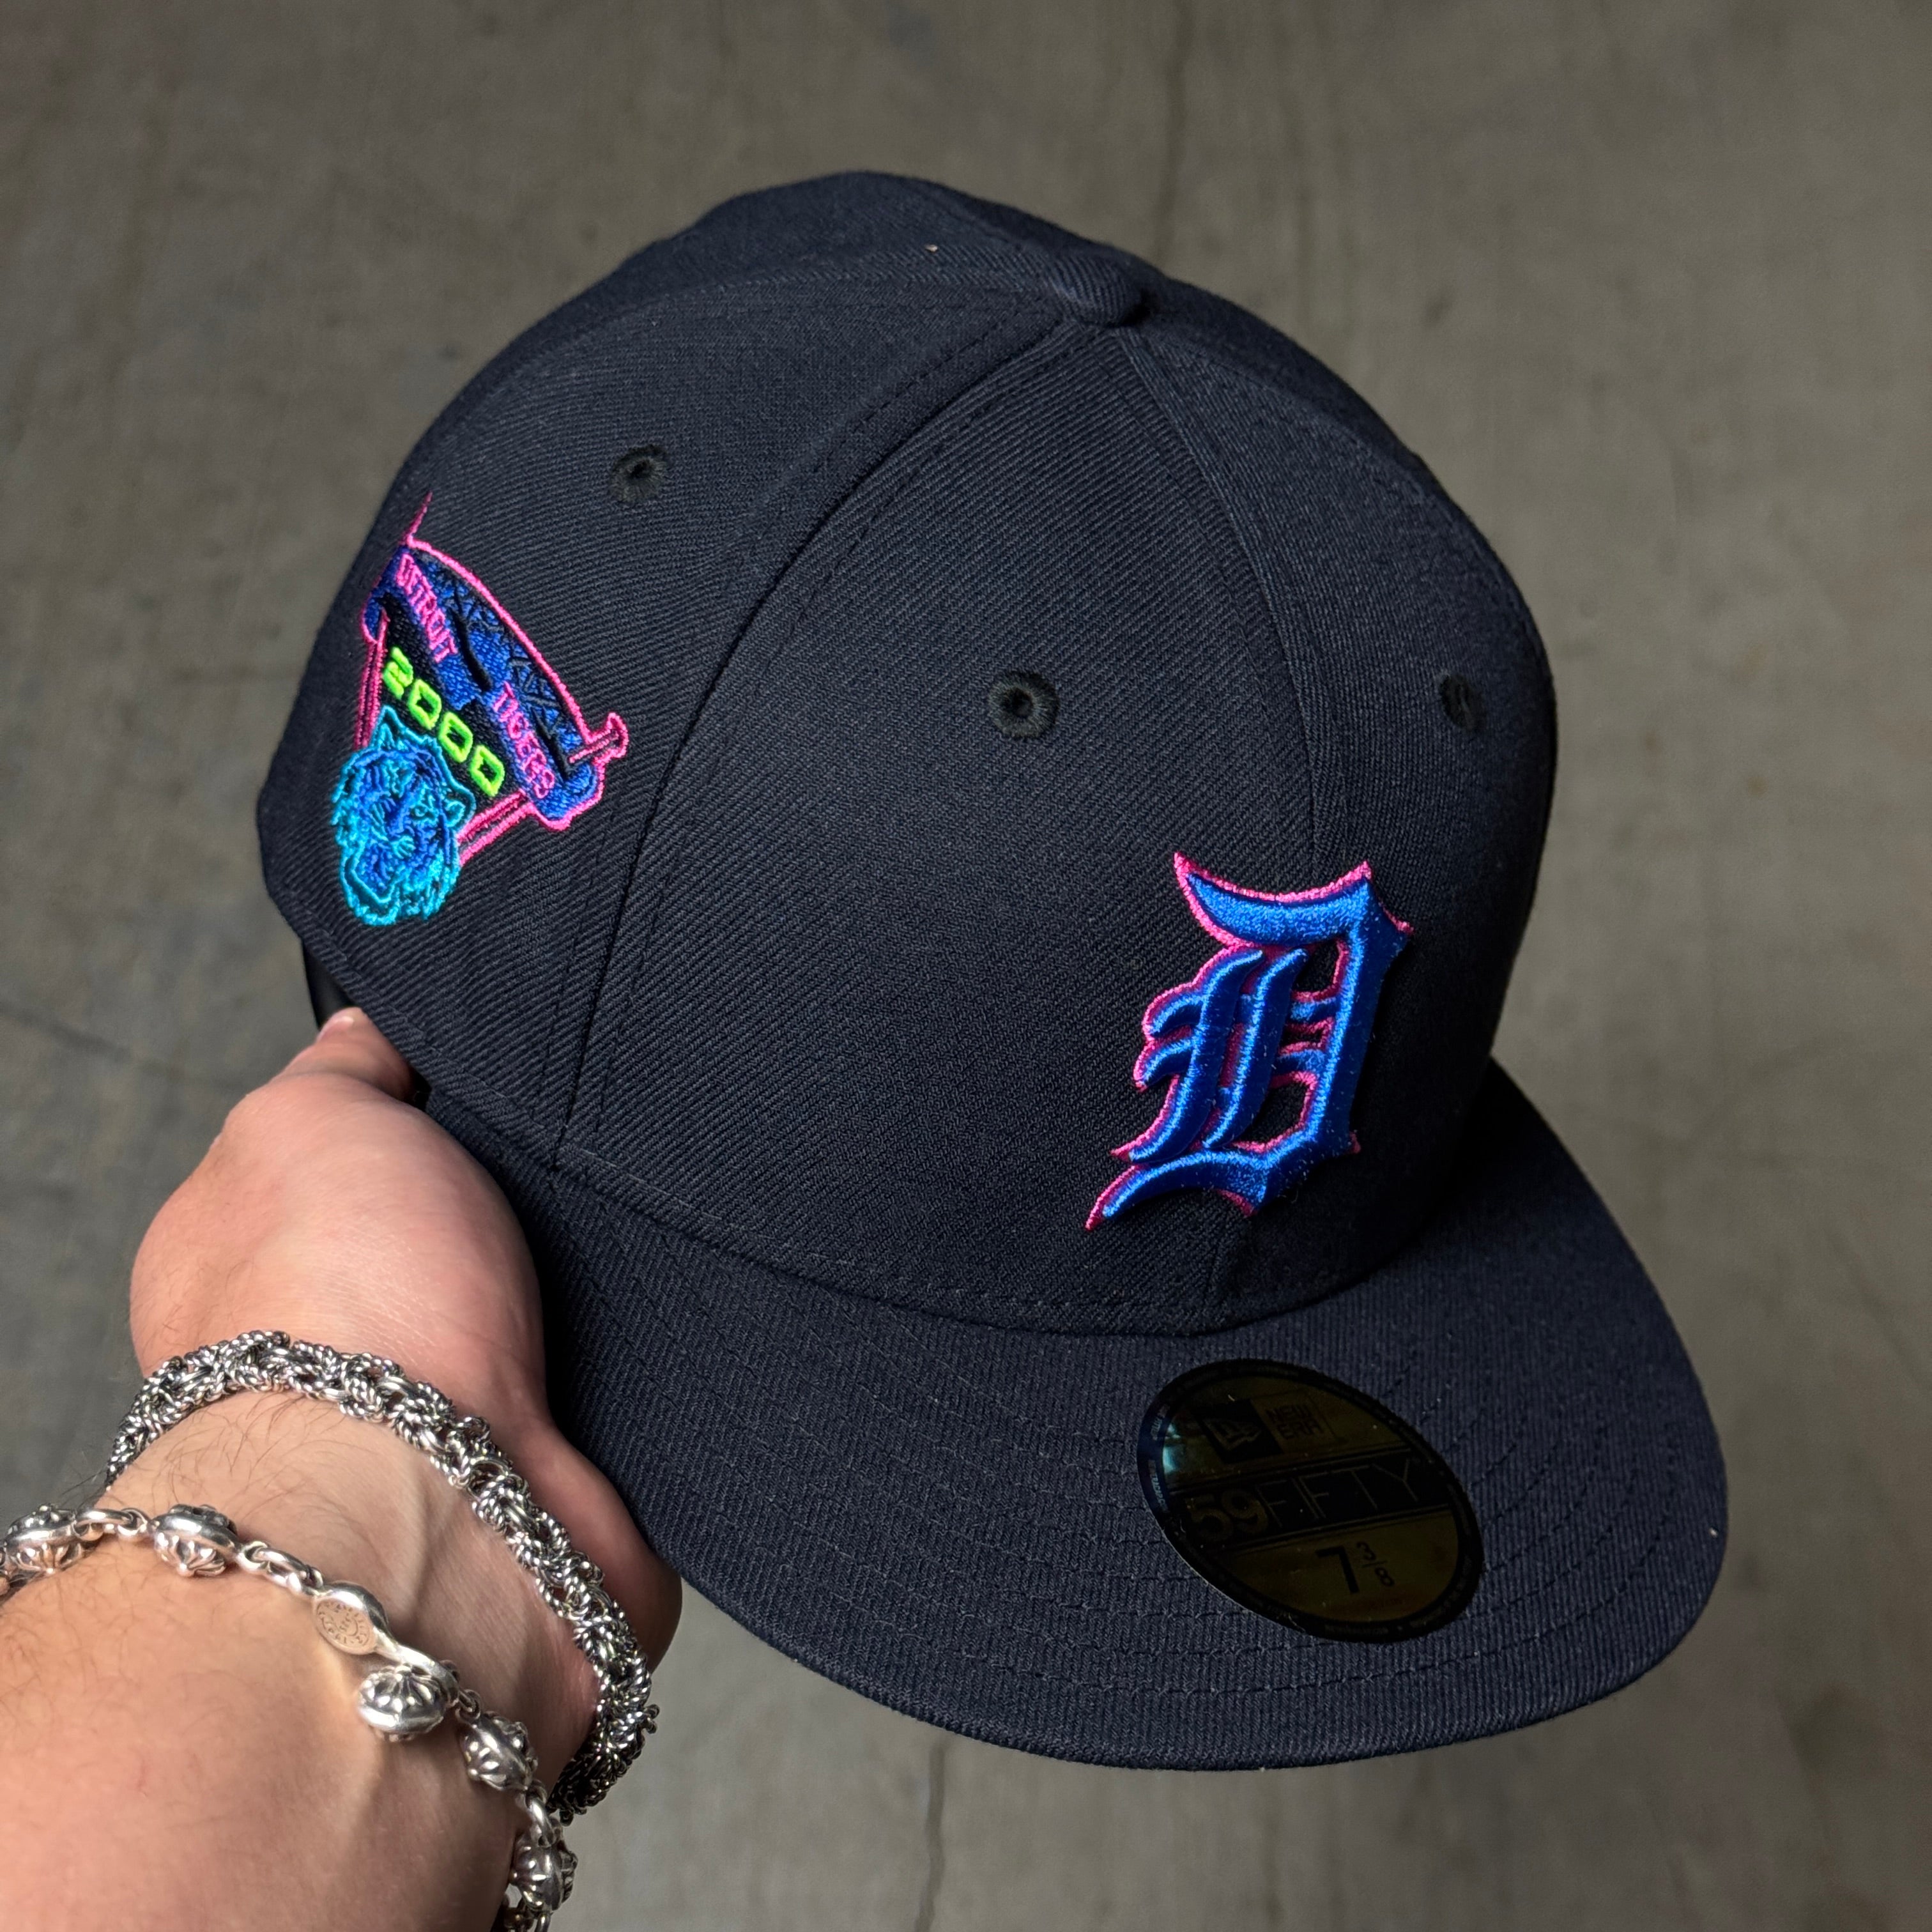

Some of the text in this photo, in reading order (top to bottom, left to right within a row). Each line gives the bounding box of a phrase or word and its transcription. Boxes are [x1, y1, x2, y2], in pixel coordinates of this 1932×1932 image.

[395, 553, 555, 799] DETROIT TIGERS
[382, 647, 505, 797] 2000
[1085, 852, 1413, 1230] D
[1265, 1404, 1313, 1425] NEW
[1276, 1418, 1324, 1440] ERA
[1183, 1457, 1420, 1543] 59FIFTY
[1315, 1544, 1360, 1595] 7
